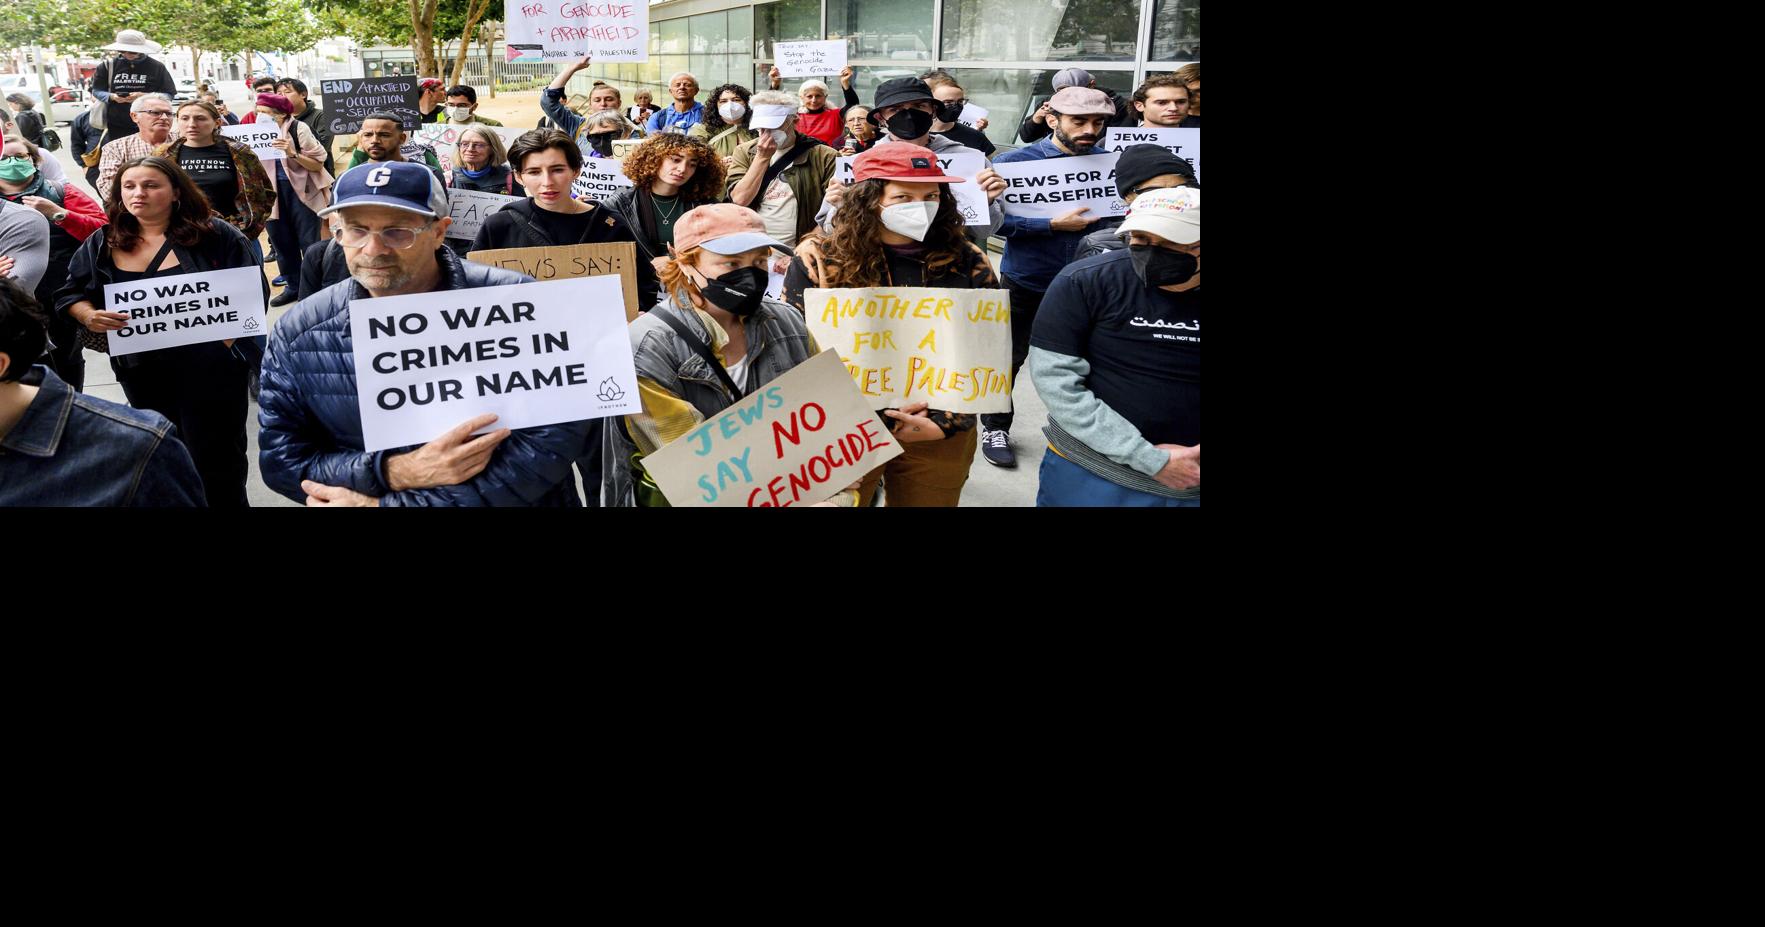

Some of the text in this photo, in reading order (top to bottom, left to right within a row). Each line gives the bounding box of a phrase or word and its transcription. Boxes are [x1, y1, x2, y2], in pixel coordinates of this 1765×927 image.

[521, 3, 634, 18] FOR GENOCIDE
[551, 25, 640, 42] APARTHEID
[600, 48, 638, 56] PALESTINE
[787, 58, 824, 66] Genocide
[322, 81, 352, 94] END
[346, 95, 404, 107] OCCUPATION
[330, 118, 362, 133] GA
[252, 132, 278, 141] FOR
[1114, 133, 1158, 141] JEWS
[366, 167, 392, 187] G
[581, 171, 615, 181] AINST
[1004, 175, 1059, 187] JEWS
[1065, 171, 1101, 183] FOR
[573, 179, 622, 191] ENOCID
[1005, 186, 1116, 203] CEASEFIRE
[570, 256, 620, 275] SAY:
[115, 281, 210, 304] NO WAR
[208, 296, 229, 308] IN
[821, 294, 954, 328] ANOTHER
[117, 311, 239, 338] OUR NAME
[368, 302, 536, 339] NO WAR
[852, 328, 936, 354] FOR A
[372, 331, 569, 374] CRIMES IN
[376, 363, 588, 410] OUR NAME
[905, 355, 1012, 402] PALESTIN
[687, 386, 784, 456] JEWS
[697, 402, 826, 503] SAY NO
[747, 419, 890, 507] GENOCIDE
